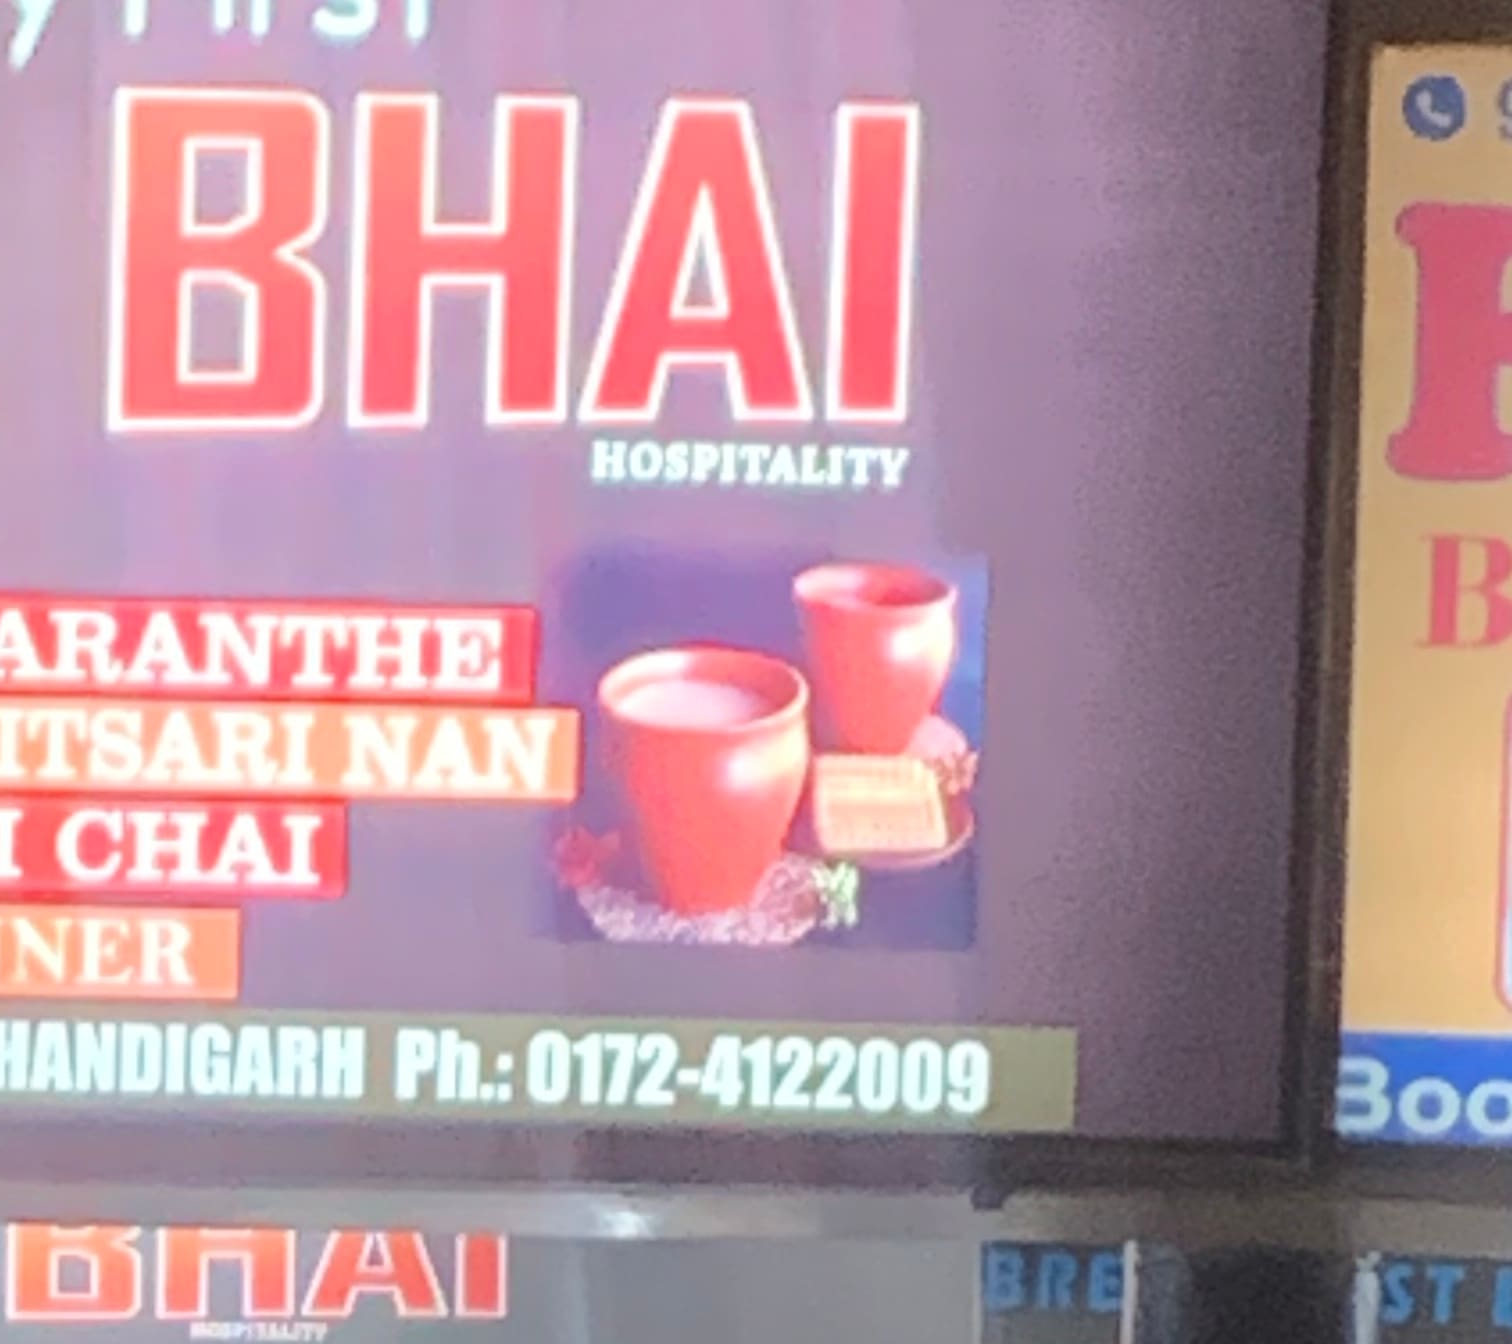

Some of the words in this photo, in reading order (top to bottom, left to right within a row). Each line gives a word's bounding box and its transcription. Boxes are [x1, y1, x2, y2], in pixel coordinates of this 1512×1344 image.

[107, 86, 920, 431] BHAI
[591, 440, 909, 486] HOSPITALITY
[342, 714, 556, 790] NAN
[56, 809, 321, 886] CHAI
[394, 1027, 513, 1102] Ph.:
[527, 1030, 991, 1115] 0172-4122009
[5, 1222, 507, 1321] BHAI
